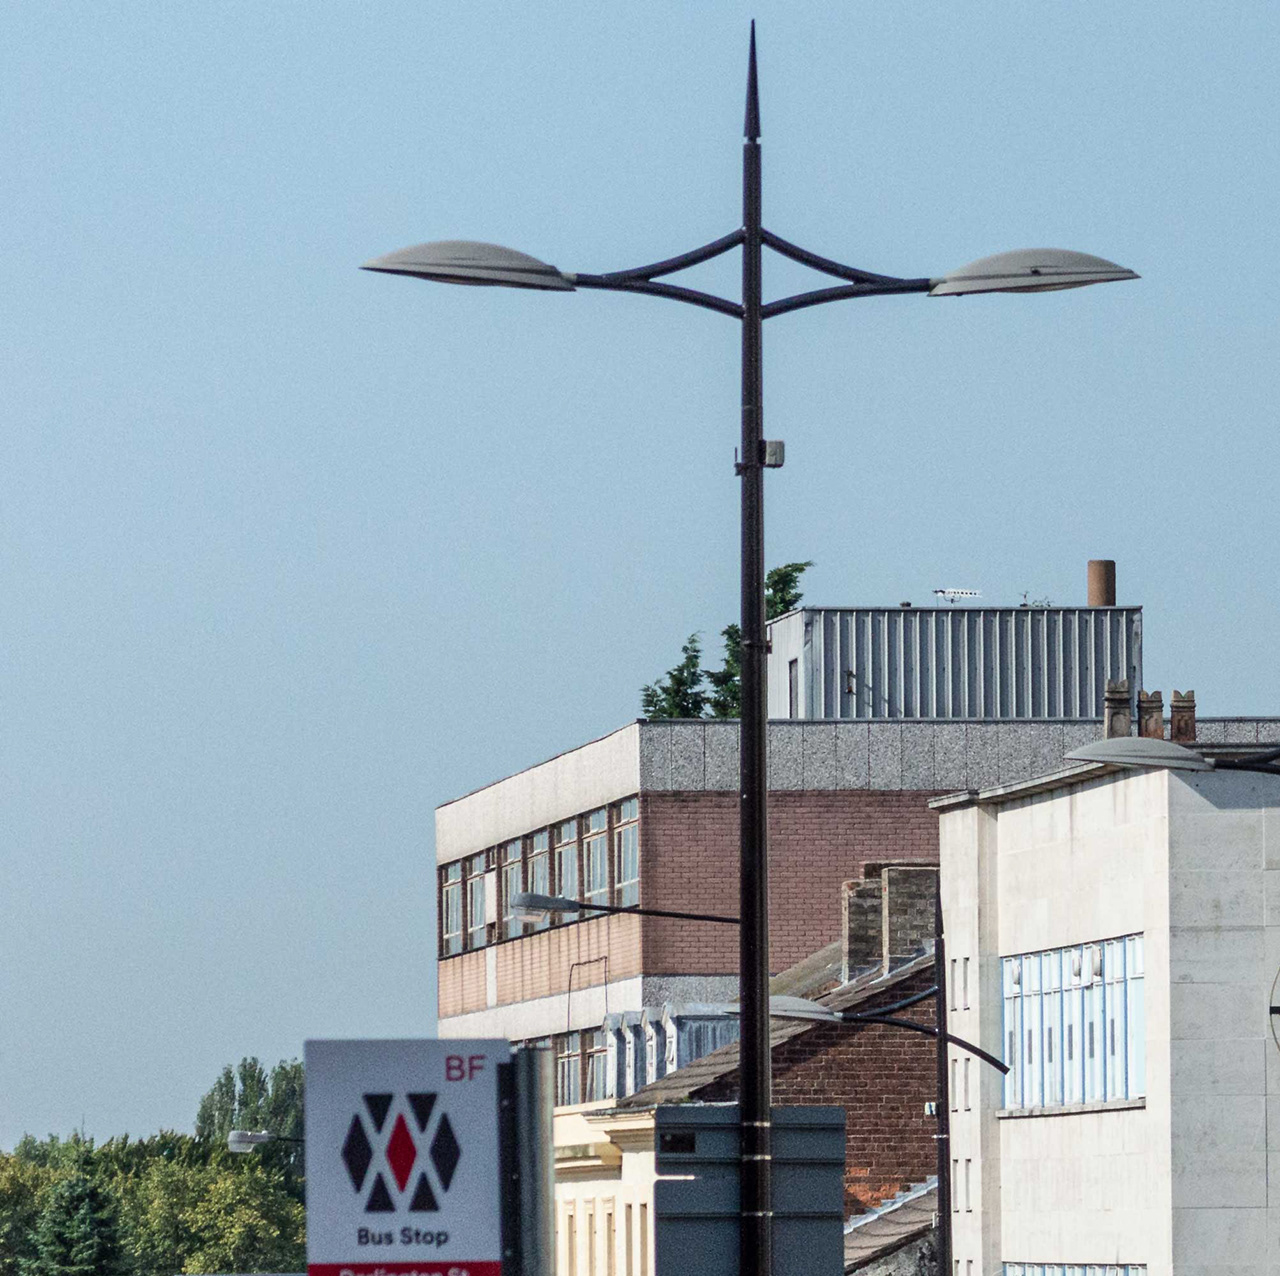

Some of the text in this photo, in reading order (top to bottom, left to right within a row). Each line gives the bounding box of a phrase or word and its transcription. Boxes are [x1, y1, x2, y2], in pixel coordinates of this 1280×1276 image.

[445, 1055, 486, 1081] BF
[357, 1227, 448, 1248] Bus Stop
